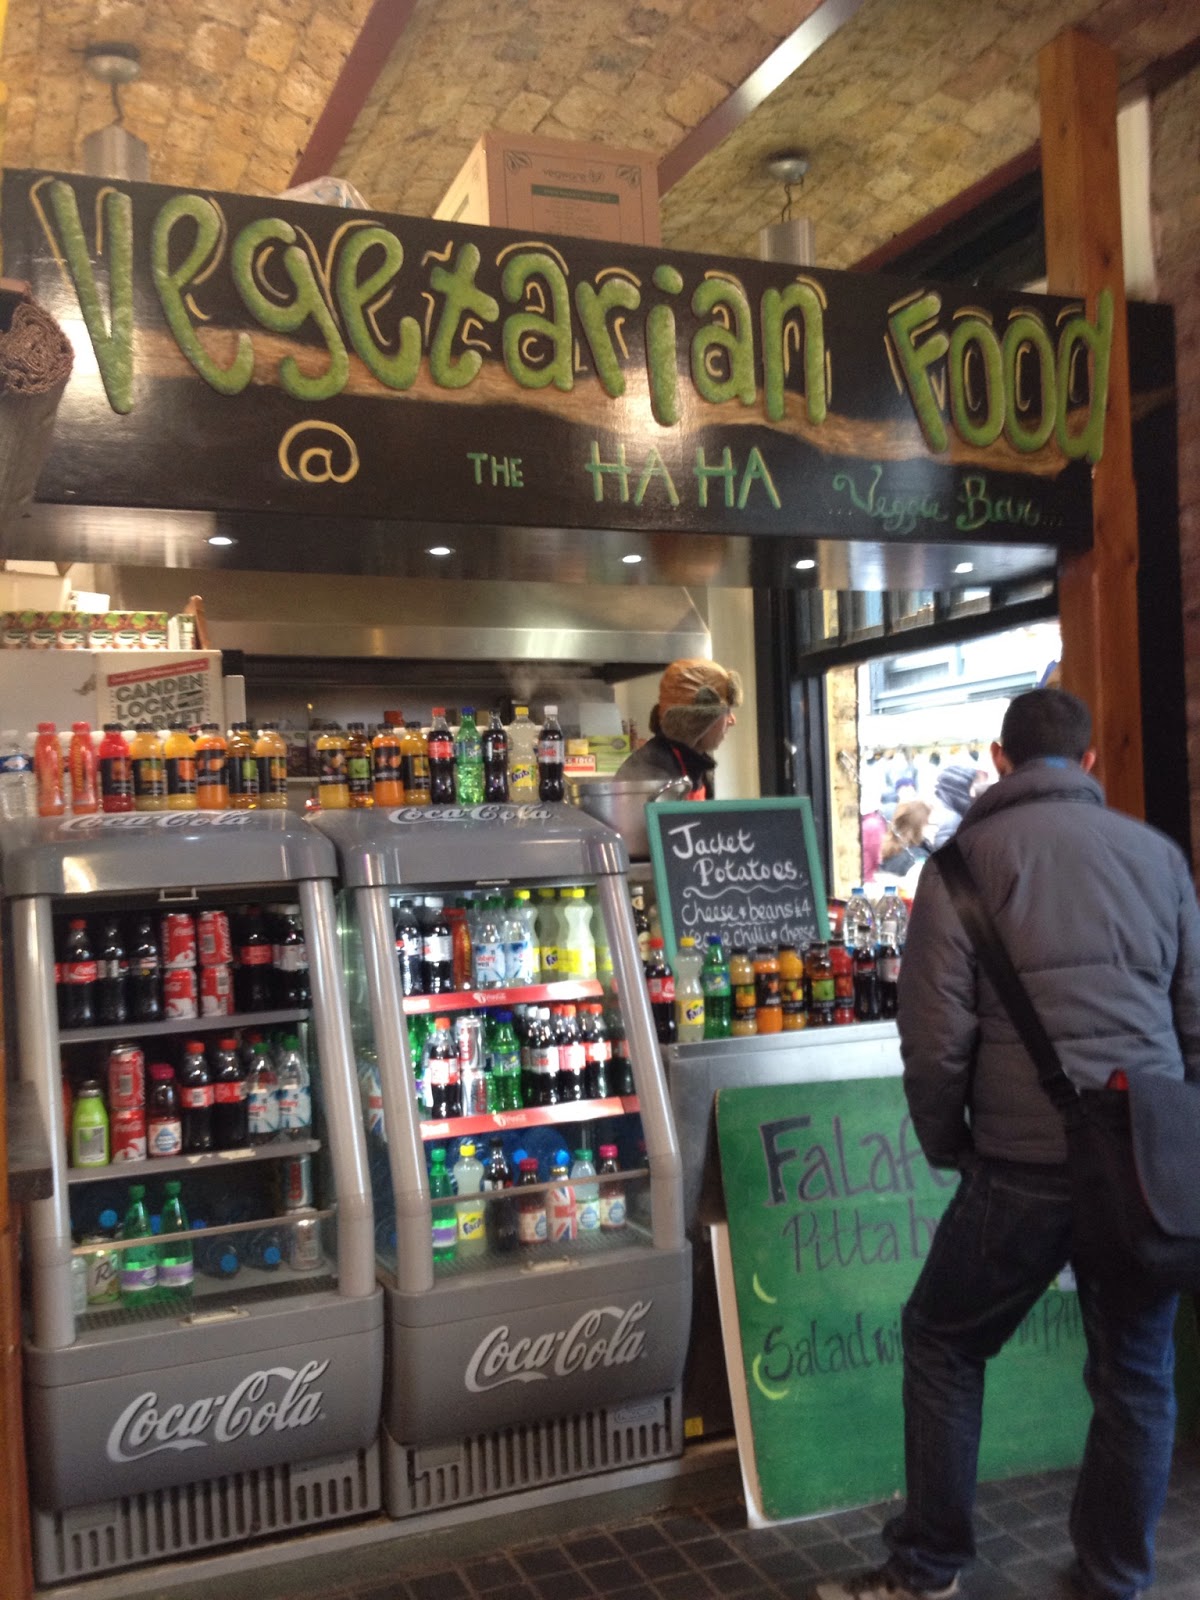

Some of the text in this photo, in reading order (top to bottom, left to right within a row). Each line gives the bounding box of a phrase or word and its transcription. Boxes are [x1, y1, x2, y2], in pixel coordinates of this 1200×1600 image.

[32, 177, 1115, 465] Vegetarian Food
[277, 418, 361, 484] @
[466, 451, 525, 489] THE
[115, 672, 204, 703] CAMDEN
[116, 694, 175, 721] LOCK
[58, 801, 253, 832] Coca-Cola
[387, 802, 556, 825] Coca-Cola
[668, 820, 756, 860] Jacket
[746, 895, 794, 921] beans
[464, 1299, 654, 1393] Coca-Cola
[763, 1302, 873, 1383] Salad
[105, 1357, 332, 1463] Coca-Cola
